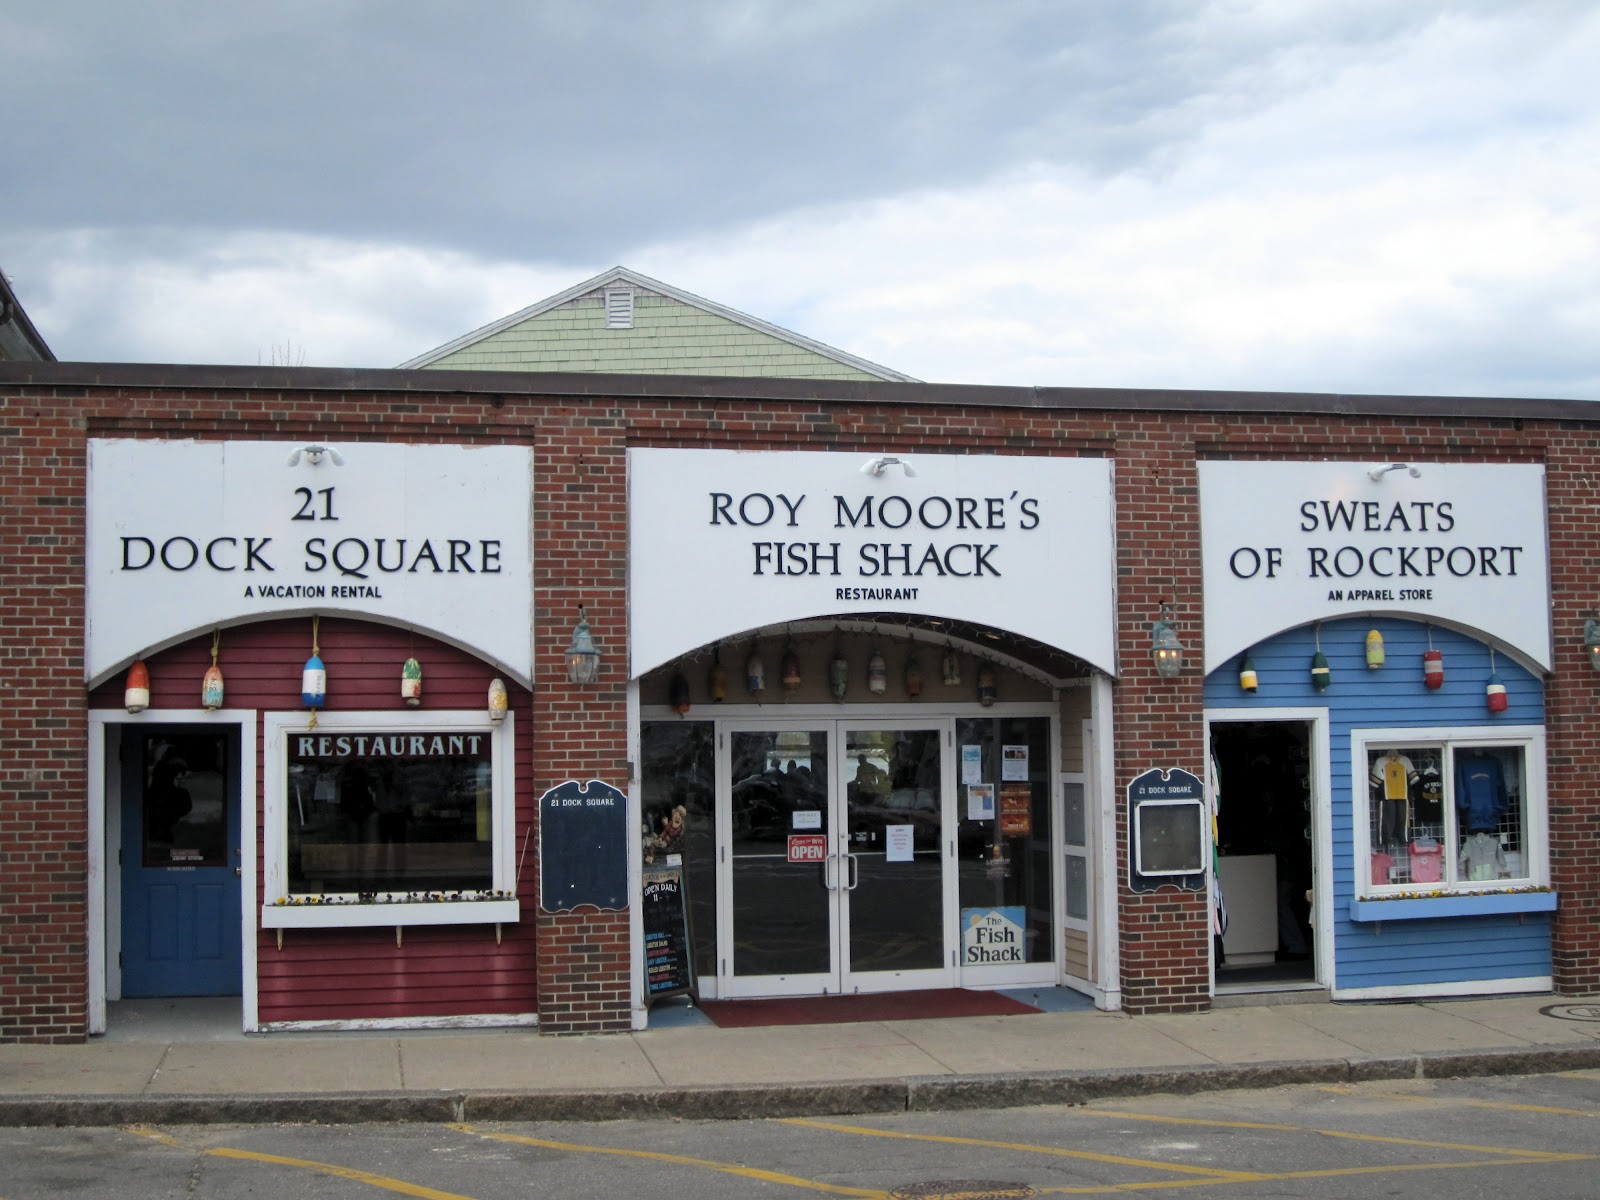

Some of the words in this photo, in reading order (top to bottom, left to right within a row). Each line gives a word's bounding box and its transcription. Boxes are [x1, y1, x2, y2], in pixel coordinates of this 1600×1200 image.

[291, 486, 339, 521] 21
[709, 492, 806, 527] ROY
[833, 490, 1040, 531] MOORE'S
[1300, 500, 1455, 533] SWEATS
[119, 536, 275, 572] DOCK
[304, 537, 502, 579] SQUARE
[751, 541, 842, 577] FISH
[859, 542, 1002, 578] SHACK
[1229, 546, 1282, 580] OF
[1307, 545, 1523, 578] ROCKPORT
[244, 585, 254, 598] A
[258, 585, 325, 599] VACATION
[331, 585, 382, 599] RENTAL
[836, 587, 919, 601] RESTAURANT
[1328, 590, 1343, 601] AN
[1347, 589, 1395, 601] APPAREL
[1399, 589, 1433, 601] STORE
[298, 735, 482, 757] RESTAURANT
[1168, 786, 1192, 794] SQUARE
[550, 799, 559, 807] 21
[562, 799, 582, 807] DOCK
[586, 798, 615, 807] SQUARE
[791, 845, 823, 859] OPEN
[644, 884, 660, 896] OPEN
[660, 883, 678, 893] DAILY
[985, 917, 1002, 926] The
[975, 927, 1015, 944] Fish
[967, 945, 1022, 963] Shack
